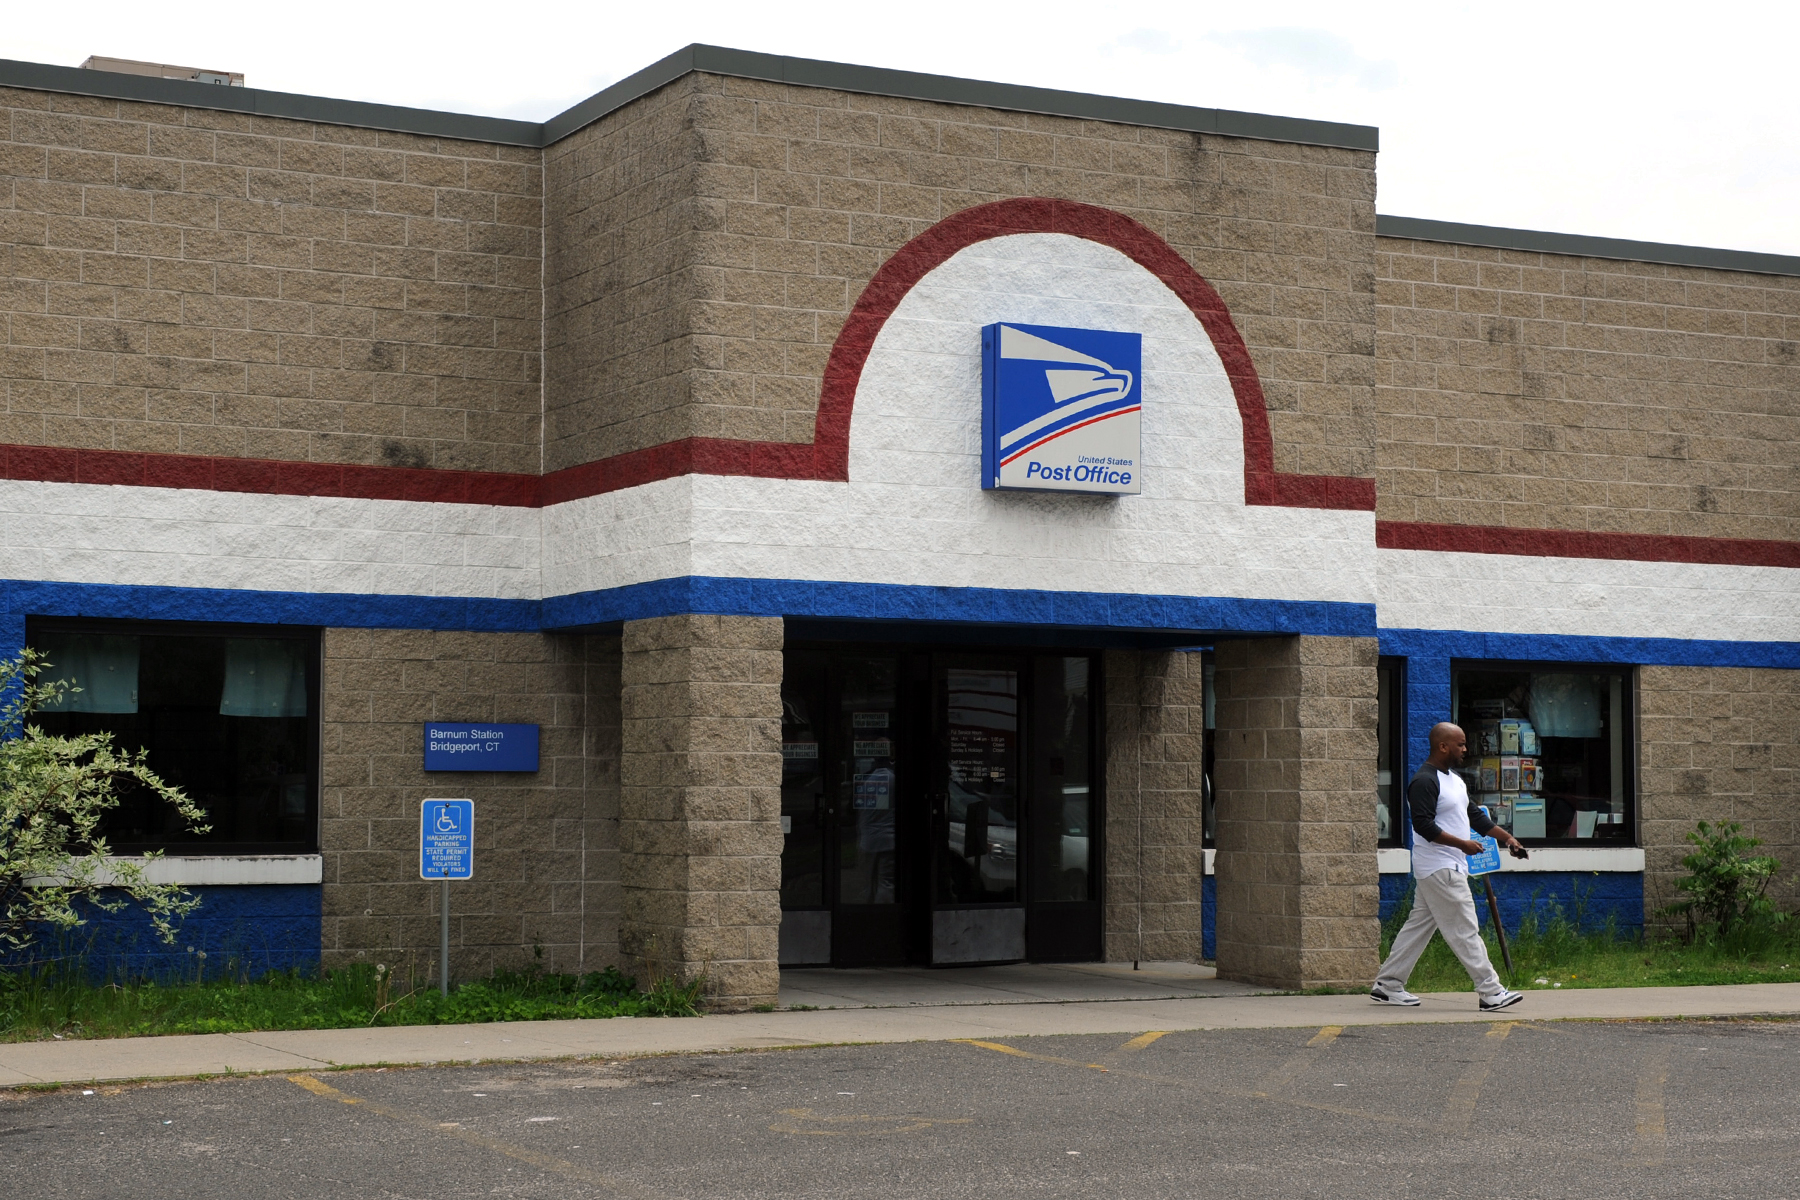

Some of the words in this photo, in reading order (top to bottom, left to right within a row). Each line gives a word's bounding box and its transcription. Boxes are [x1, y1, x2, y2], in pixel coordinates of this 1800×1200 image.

[1078, 455, 1105, 464] United
[1107, 457, 1133, 466] States
[1026, 461, 1072, 481] Post
[1074, 465, 1132, 485] Office
[430, 729, 468, 739] Barnum
[470, 729, 504, 739] Station
[430, 741, 482, 754] Bridgeport,
[485, 742, 500, 752] CT
